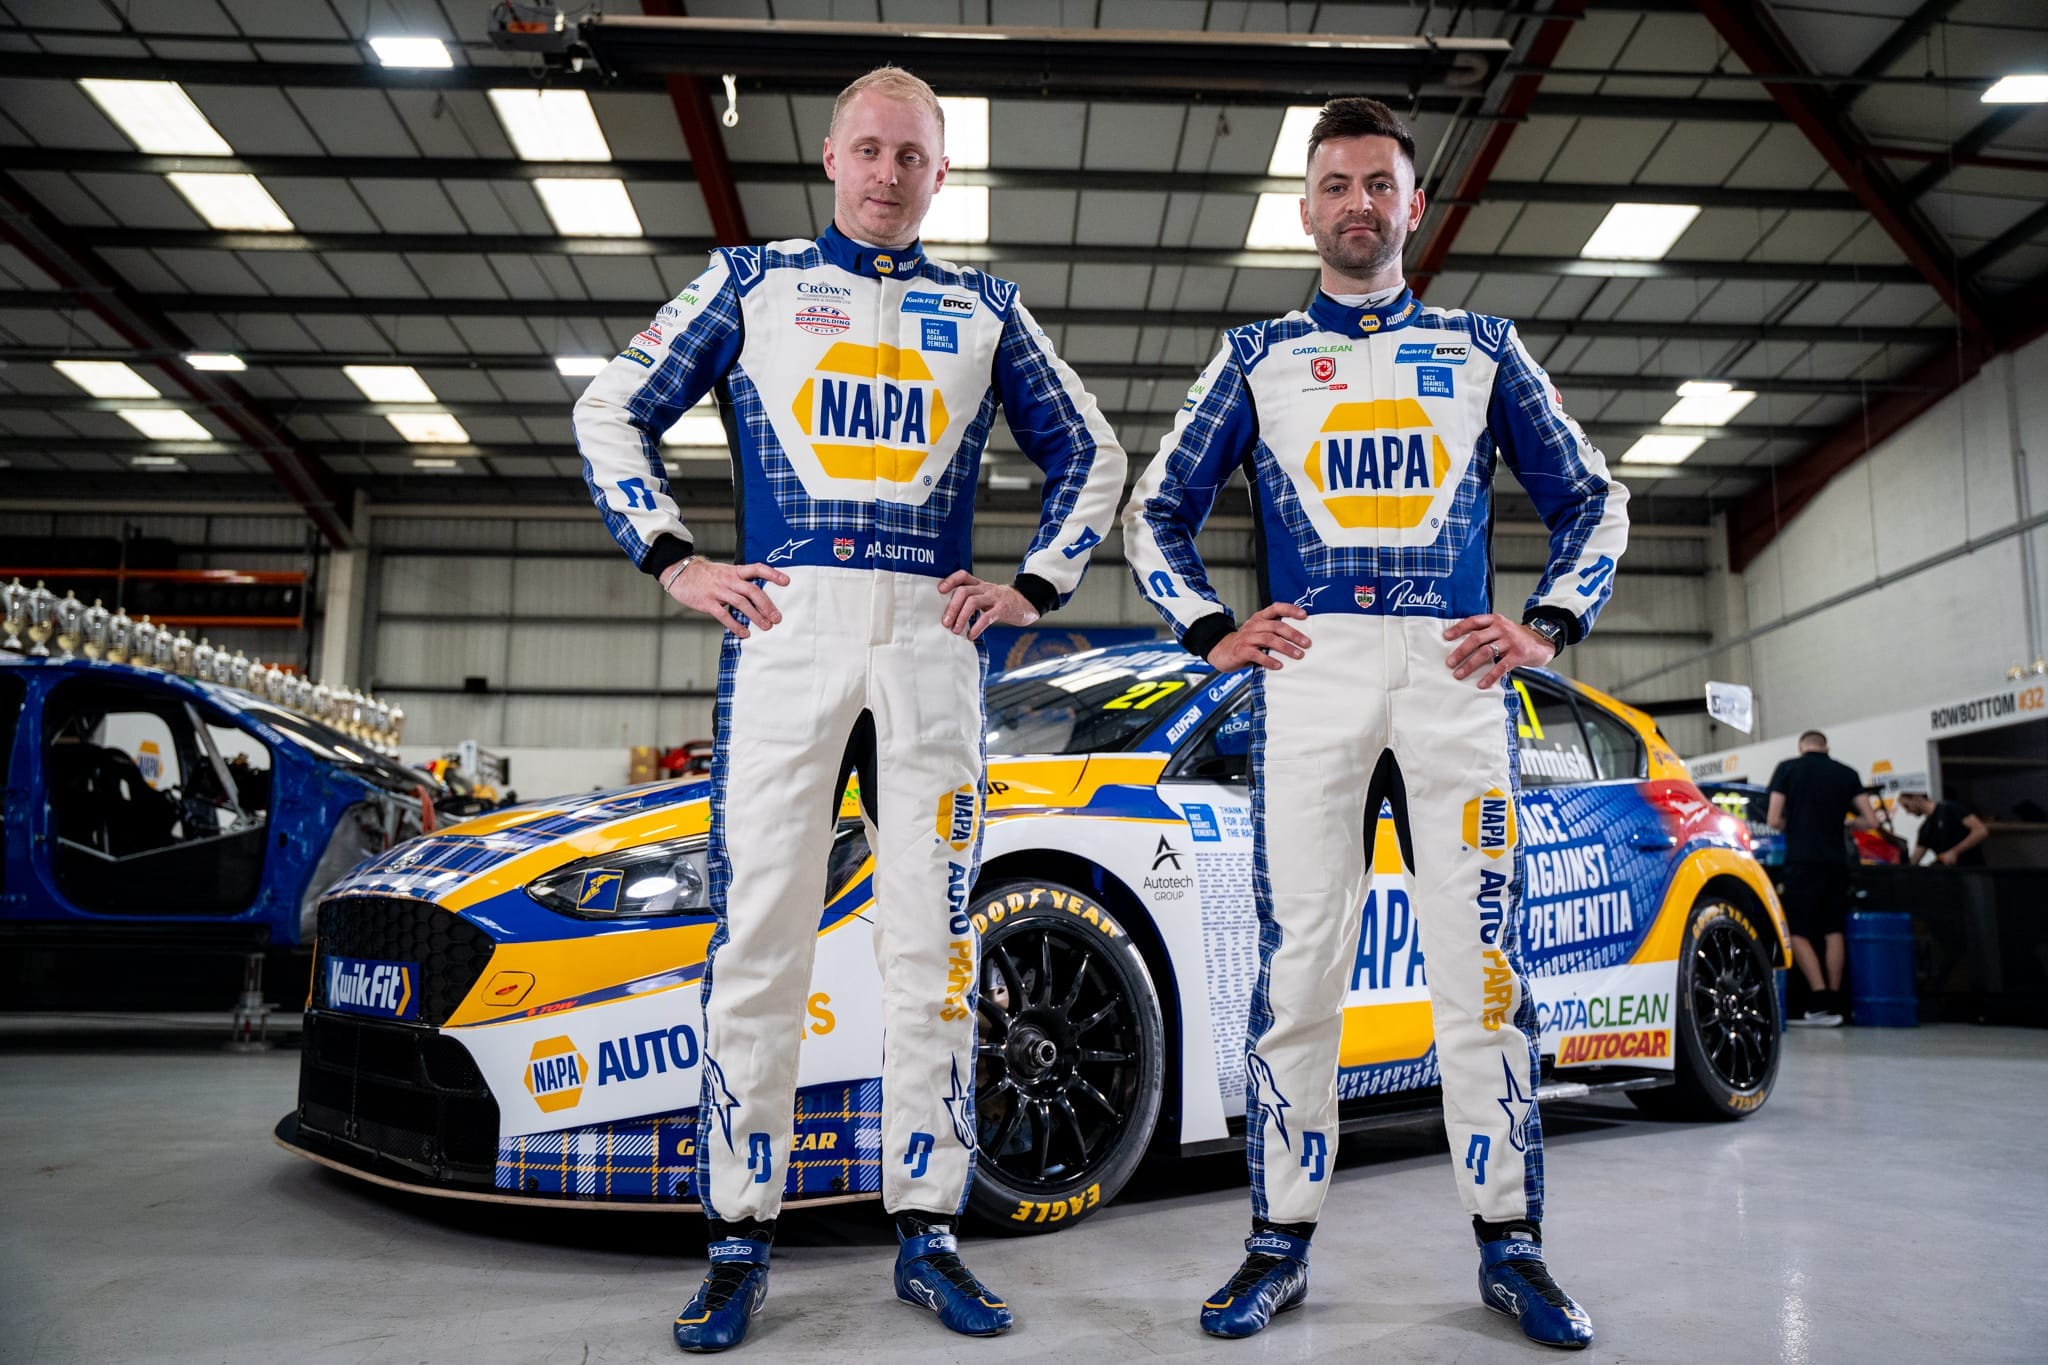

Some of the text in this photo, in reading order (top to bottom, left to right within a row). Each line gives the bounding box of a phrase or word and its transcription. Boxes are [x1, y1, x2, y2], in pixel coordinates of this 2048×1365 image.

[795, 316, 850, 326] SCAFFOLDING
[943, 299, 972, 310] BTCC
[1386, 312, 1404, 326] AUTO
[1292, 345, 1352, 355] CATACLEAN
[1436, 347, 1466, 355] BTCC
[820, 378, 926, 445] NAPA
[1327, 434, 1430, 491] NAPA
[1103, 681, 1185, 710] 27
[1930, 687, 2045, 730] ROWBOTTOM #32
[951, 793, 975, 842] NAPA
[1480, 799, 1508, 849] NAPA
[1143, 875, 1194, 889] Autotech
[1525, 844, 1610, 899] AGAINST
[947, 861, 971, 936] AUTO
[1154, 891, 1185, 901] GROUP
[1476, 869, 1507, 945] AUTO
[1350, 889, 1428, 991] APA
[1527, 889, 1634, 951] DEMENTIA
[1536, 992, 1670, 1033] CATACLEAN
[533, 1024, 699, 1094] NAPA AUTO
[1560, 1030, 1667, 1065] AUTOCAR
[1011, 1183, 1101, 1223] EAGLE
